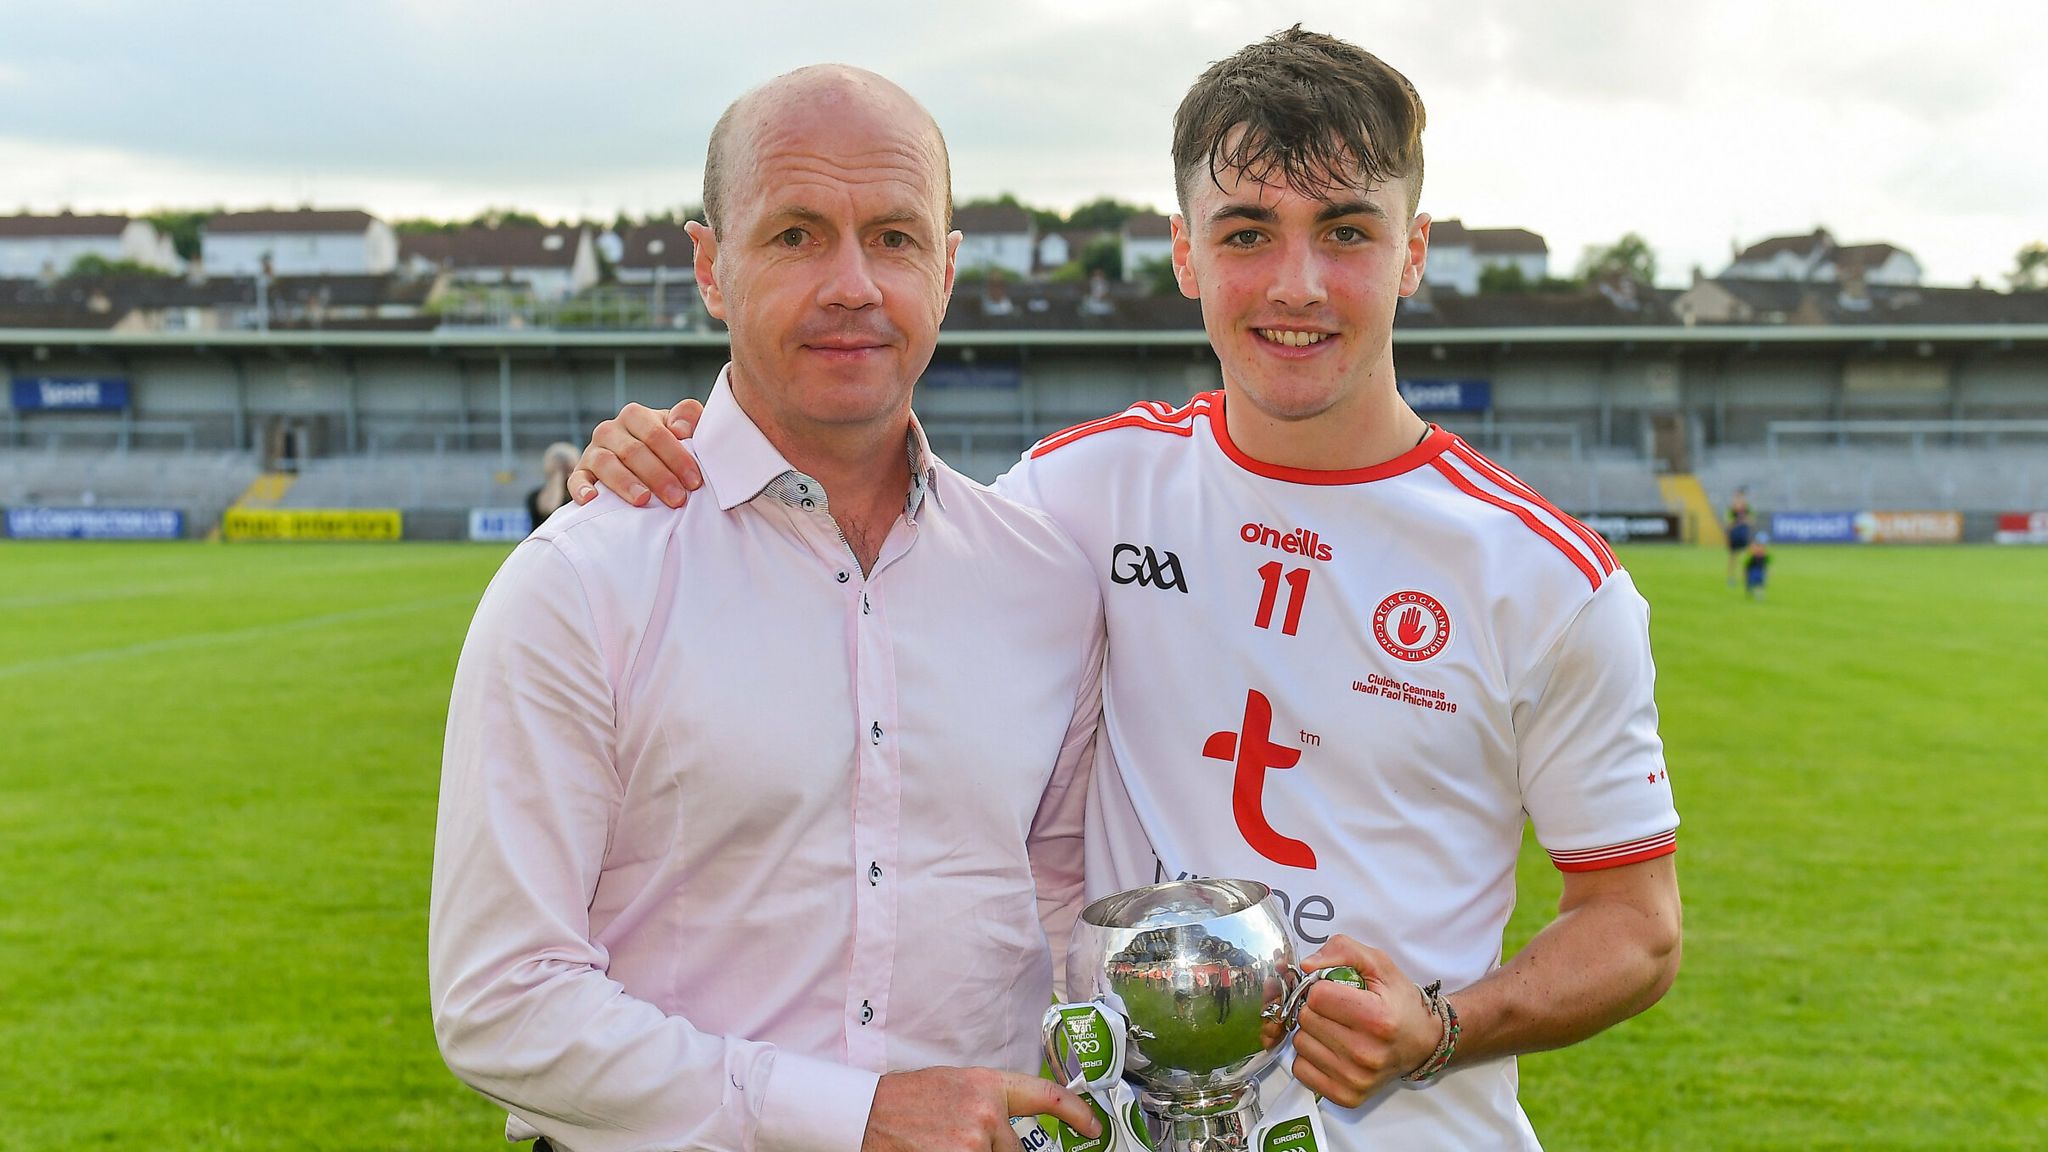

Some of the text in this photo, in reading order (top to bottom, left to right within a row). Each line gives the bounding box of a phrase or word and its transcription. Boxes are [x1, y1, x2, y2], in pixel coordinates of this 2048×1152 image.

[1254, 560, 1311, 636] 11
[1352, 681, 1457, 714] Uladh Faoi Fhiche 2019
[1367, 673, 1445, 700] Cluiche Ceannais
[1273, 1131, 1306, 1145] EIRGRID
